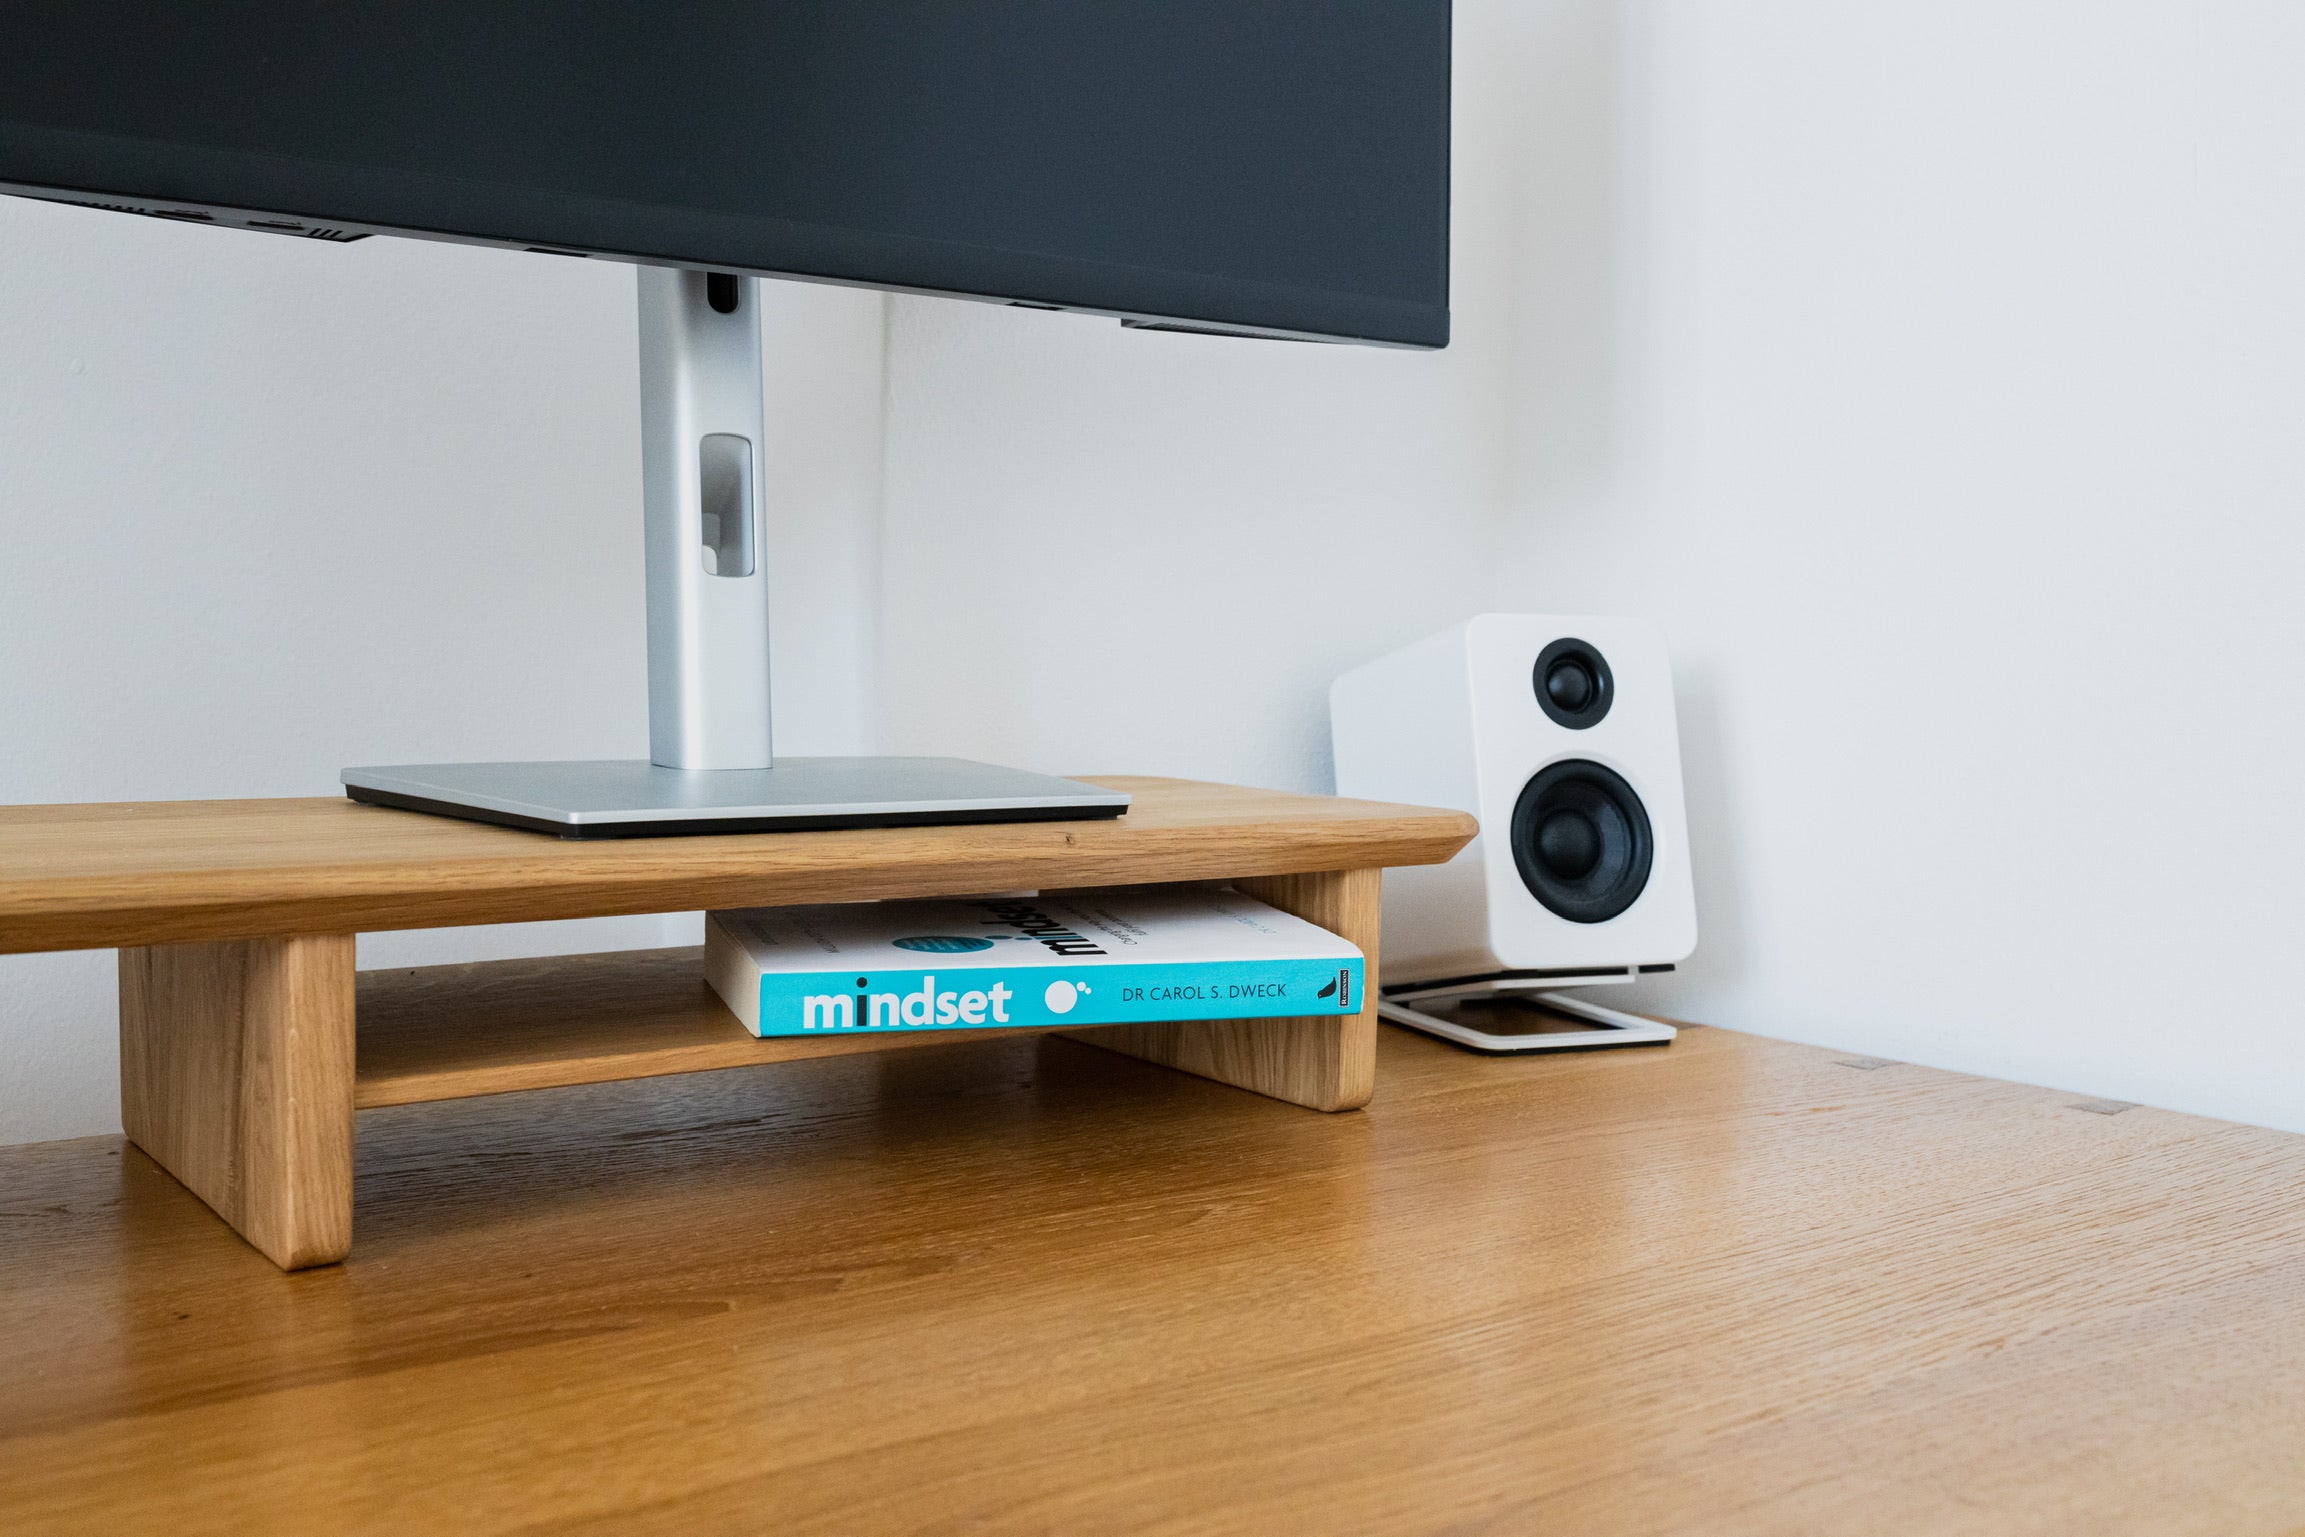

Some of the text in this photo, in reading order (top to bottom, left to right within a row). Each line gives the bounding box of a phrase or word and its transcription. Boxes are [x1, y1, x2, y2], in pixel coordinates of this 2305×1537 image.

[803, 975, 1013, 1029] mindset
[1122, 983, 1287, 1001] DR CAROL S. DWECK
